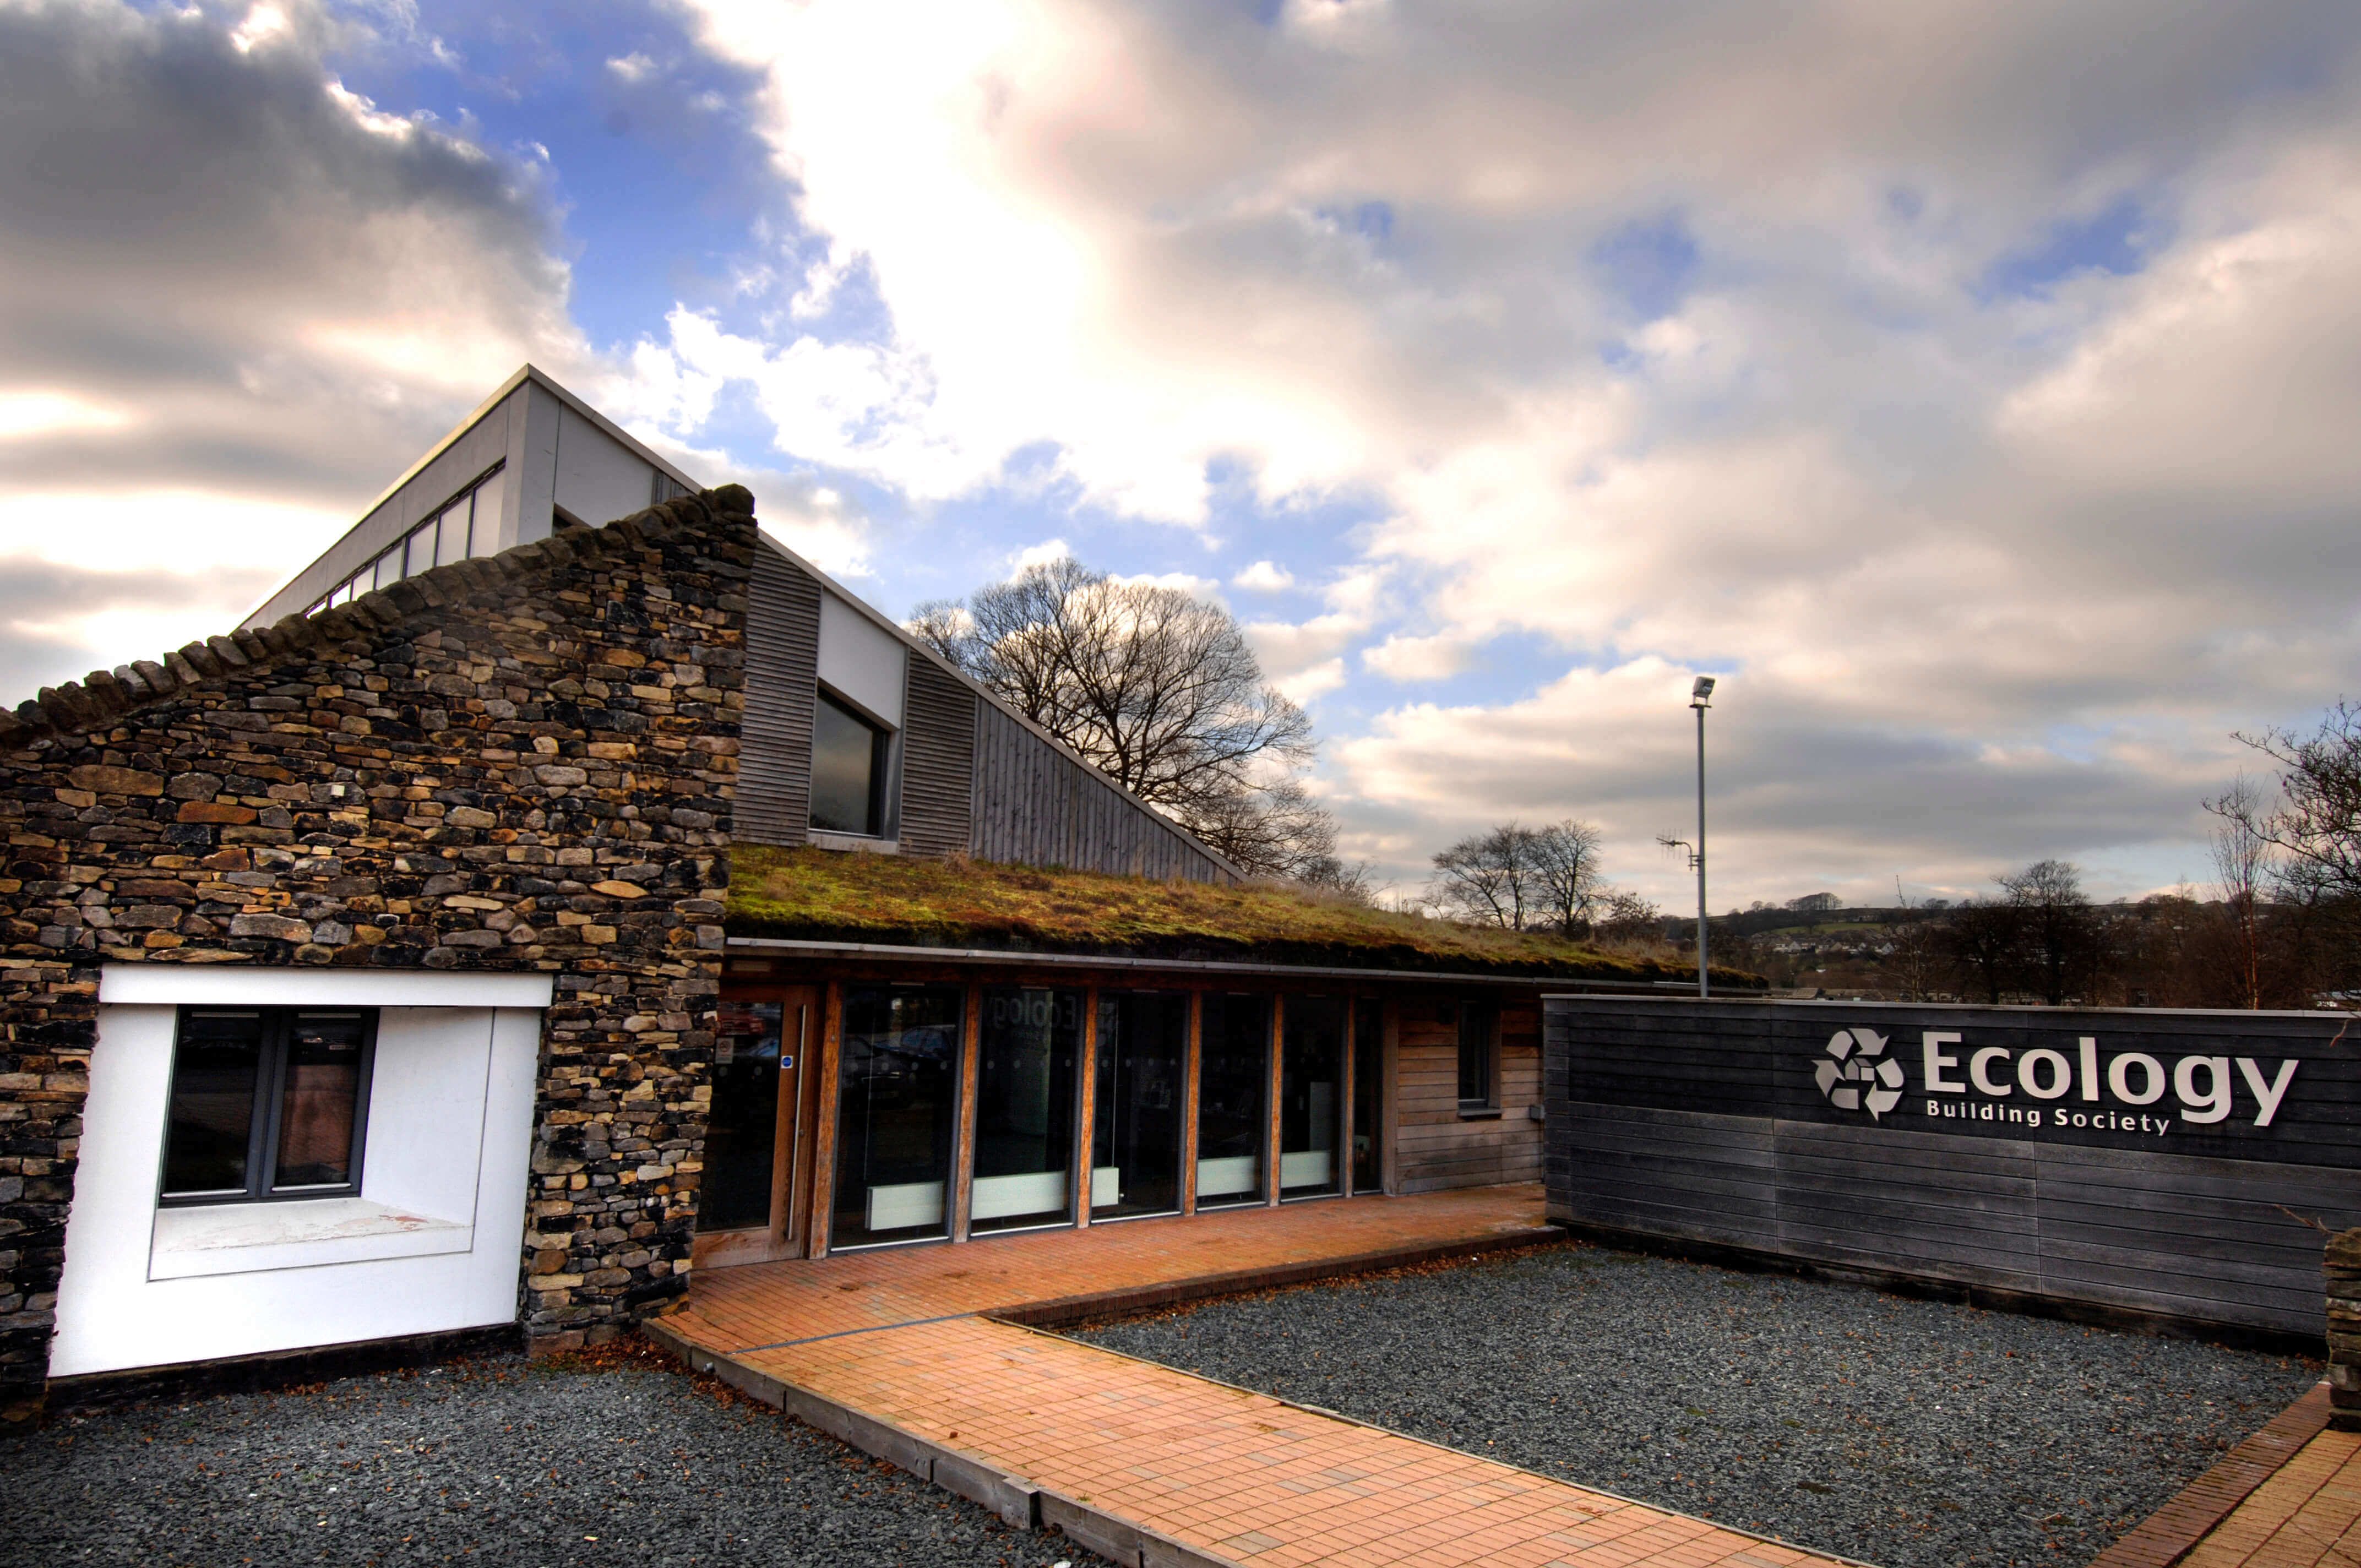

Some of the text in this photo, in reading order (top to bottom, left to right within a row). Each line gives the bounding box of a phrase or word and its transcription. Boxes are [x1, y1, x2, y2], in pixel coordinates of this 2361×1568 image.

[1922, 1032, 2299, 1127] Ecology
[1927, 1100, 2169, 1136] Building Society
